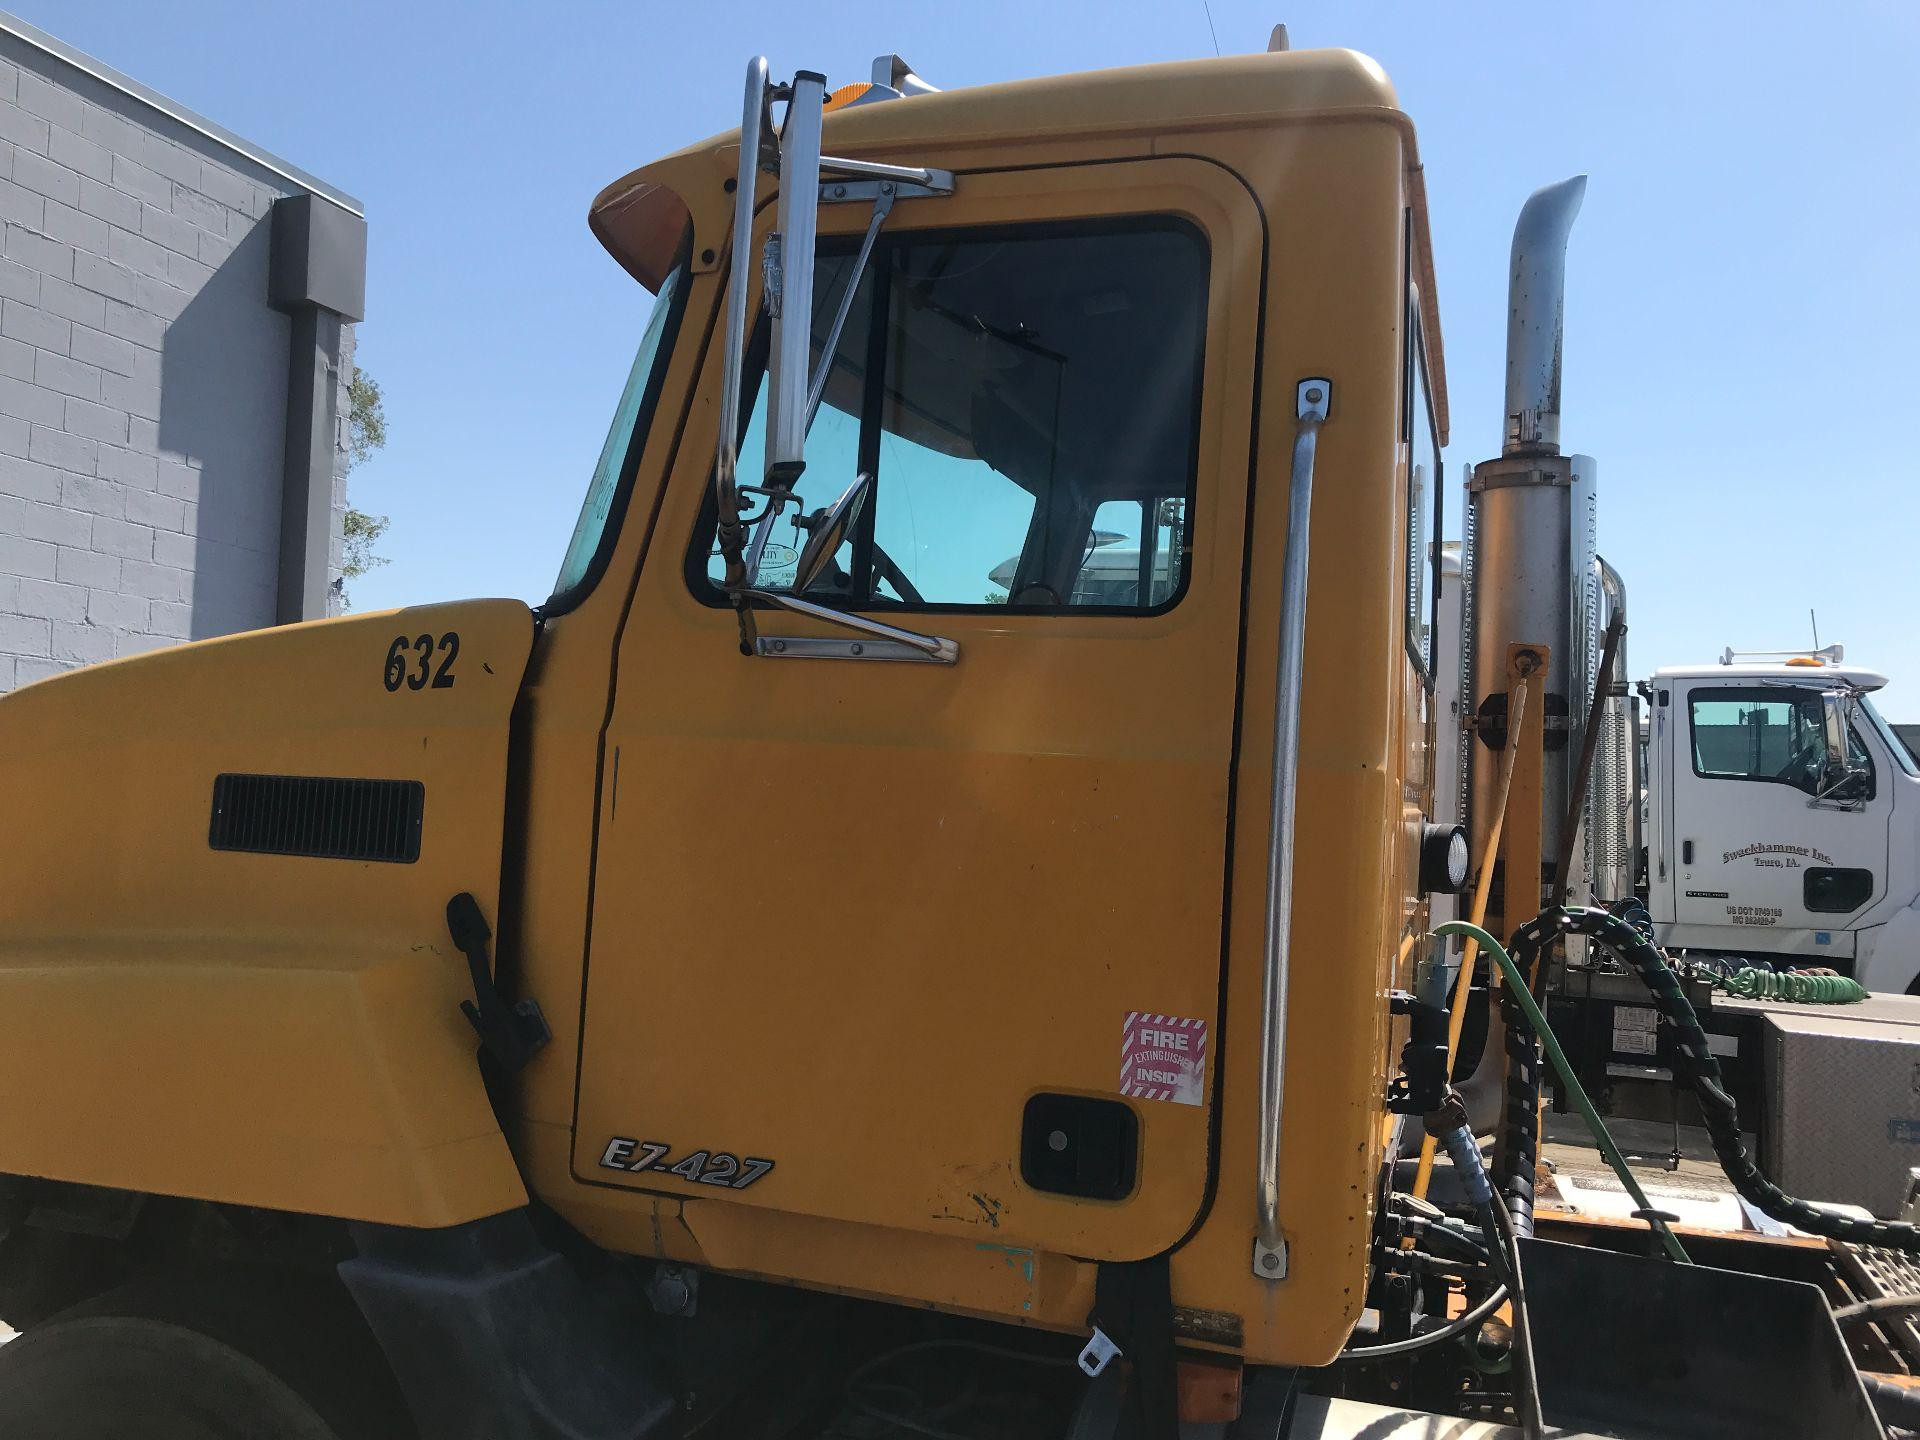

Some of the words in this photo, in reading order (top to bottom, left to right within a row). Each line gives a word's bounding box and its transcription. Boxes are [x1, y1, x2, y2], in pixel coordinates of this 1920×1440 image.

[384, 631, 460, 692] 632
[1722, 842, 1810, 865] Swackhammer
[1811, 847, 1834, 866] Inc.
[1726, 905, 1737, 915] US
[1737, 906, 1754, 916] DOT
[1140, 1028, 1189, 1051] FIRE
[1134, 1050, 1195, 1070] EXTINGUISHE
[599, 1137, 775, 1189] E7-427
